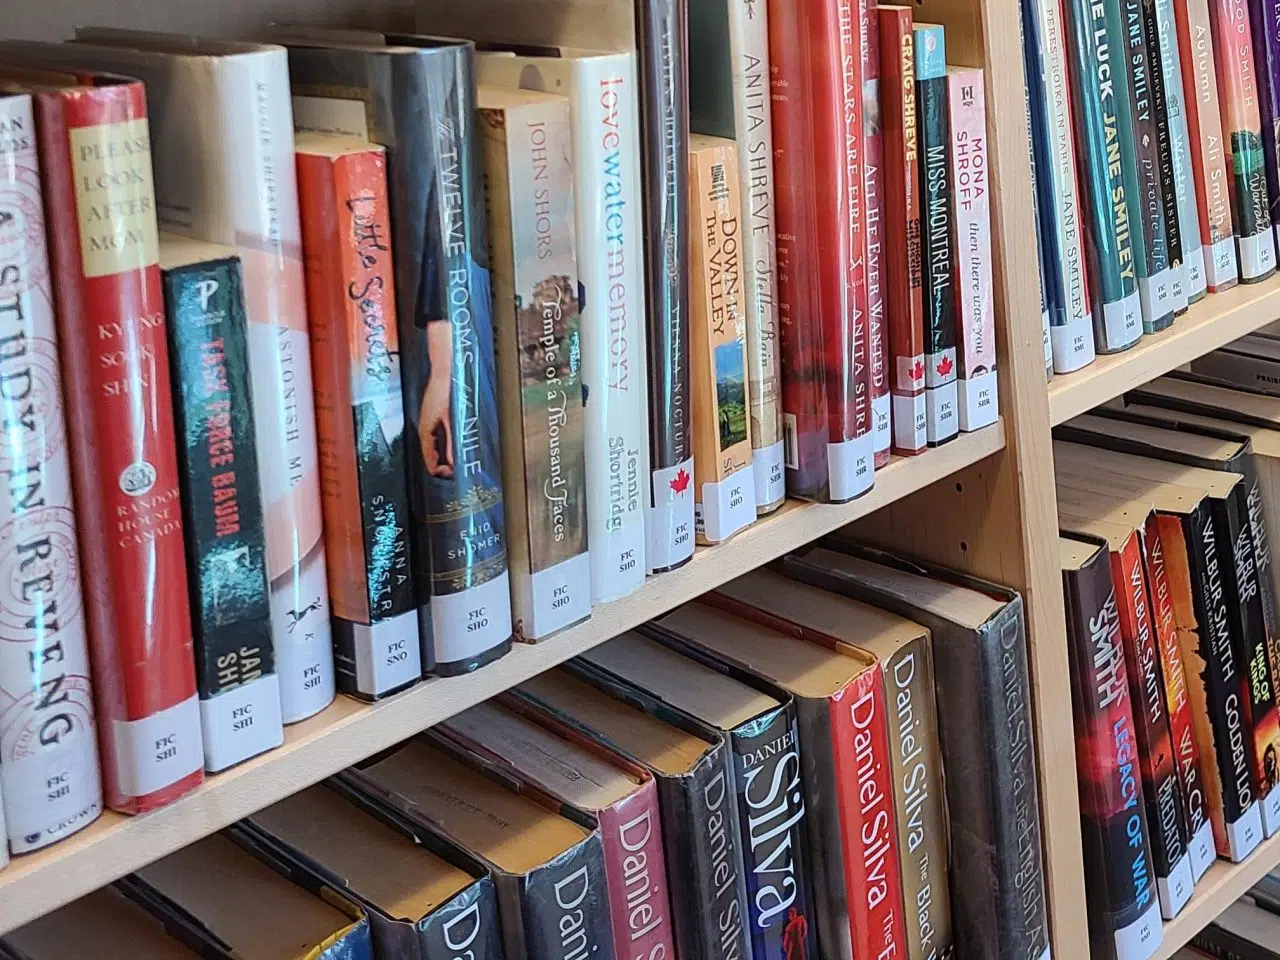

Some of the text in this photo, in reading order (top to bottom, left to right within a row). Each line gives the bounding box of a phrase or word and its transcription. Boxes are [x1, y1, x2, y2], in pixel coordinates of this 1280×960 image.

[838, 2, 852, 44] THE
[1092, 27, 1114, 102] LUCK
[839, 54, 855, 124] STARS
[902, 33, 917, 162] CRAIG SHREVE
[1239, 45, 1253, 108] SMITH
[846, 134, 858, 177] ARE
[971, 138, 985, 200] MONA
[1102, 112, 1122, 179] JANE
[1125, 1, 1166, 270] JANE SMILEY private life
[1195, 24, 1225, 226] Autumn Ali Smith
[83, 170, 146, 193] LOOK
[87, 196, 152, 223] AFTER
[437, 148, 467, 259] TWELVE
[527, 121, 553, 260] JOHN SHORS
[743, 53, 776, 368] ANITA SHREVE Stella Bain
[847, 184, 860, 234] FIRE
[955, 131, 972, 212] SHROFF
[927, 144, 950, 295] MISS MONTREAL
[1112, 185, 1135, 280] SMILEY
[706, 213, 725, 337] THE VALLEY
[721, 216, 740, 322] DOWN IN
[864, 164, 884, 388] ALL HE EVER WANTED
[969, 221, 984, 355] then there was you
[449, 267, 475, 367] ROOMS
[853, 308, 866, 373] ANITA
[276, 325, 300, 441] ASTONISH
[460, 416, 484, 479] NILE
[627, 448, 640, 512] Jennie
[115, 519, 182, 550] CANADA
[116, 508, 172, 534] HOUSE
[391, 524, 408, 586] ANNA
[447, 533, 502, 560] SHOMER
[467, 618, 489, 633] SHO
[468, 606, 486, 621] FIC
[1131, 559, 1163, 724] WILBUR SMITH
[1202, 515, 1224, 609] WILBUR
[1214, 604, 1236, 683] SMITH
[1225, 693, 1247, 775] GOLDEN
[1090, 611, 1118, 708] SMITH
[1151, 536, 1175, 635] WILBUR
[1166, 631, 1187, 714] SMITH
[1179, 726, 1196, 793] WAR
[1249, 658, 1261, 705] KINGS
[1254, 641, 1270, 702] KING OF
[231, 703, 253, 720] FIC
[232, 714, 255, 733] SHI
[741, 727, 798, 770] DANIEL
[850, 690, 886, 817] Daniel
[743, 751, 806, 930] Silva
[894, 651, 936, 947] Daniel Silva The Black
[1112, 715, 1150, 910] LEGACY OF WAR
[618, 807, 665, 941] Daniel
[704, 767, 740, 960] Daniel Silv
[860, 809, 892, 910] Silva
